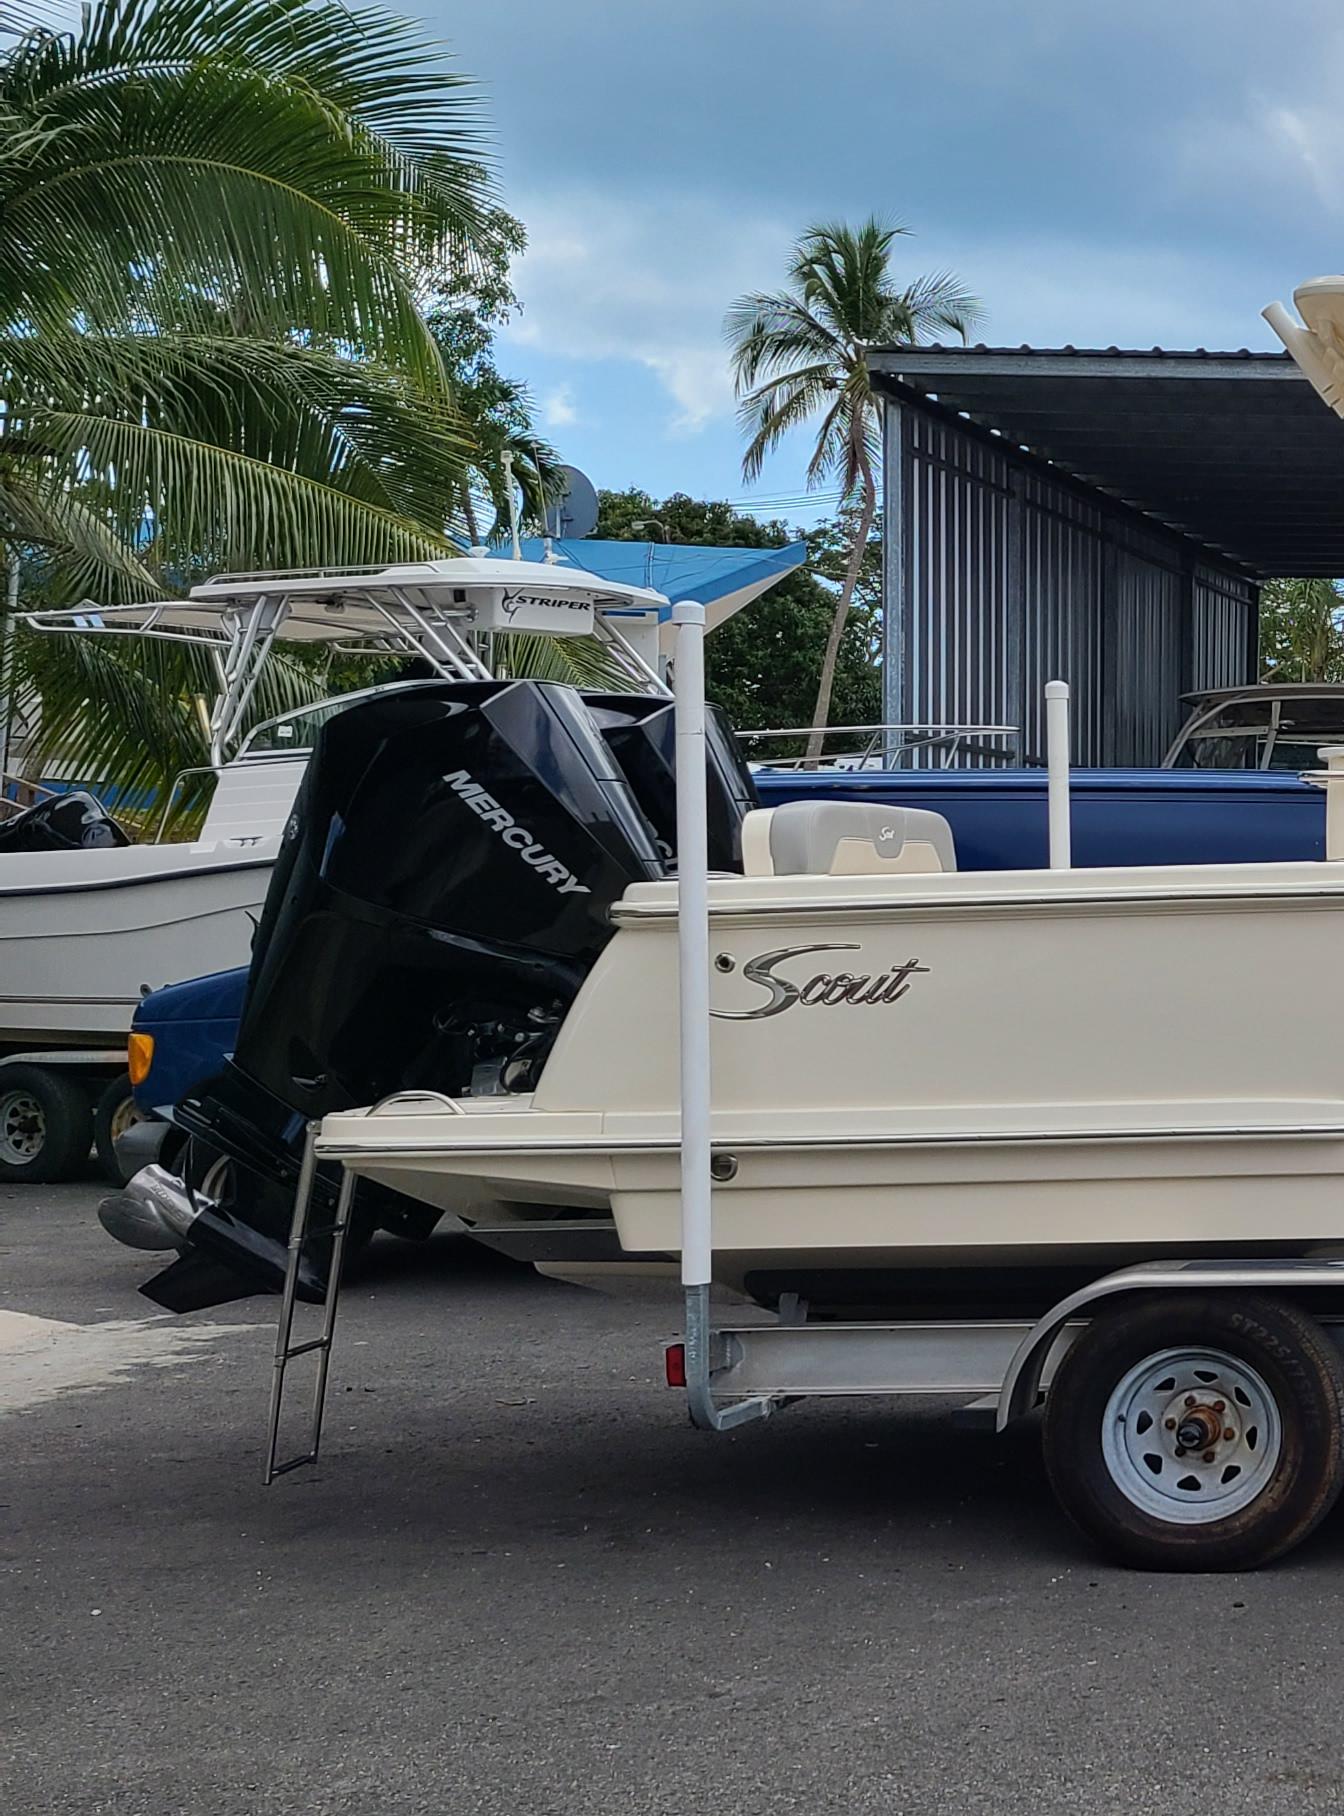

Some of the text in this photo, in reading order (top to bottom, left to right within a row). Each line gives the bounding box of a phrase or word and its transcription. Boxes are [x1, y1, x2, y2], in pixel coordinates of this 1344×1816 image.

[515, 595, 591, 611] STRIPER
[442, 769, 592, 894] MERCURY
[709, 943, 931, 1020] Scout
